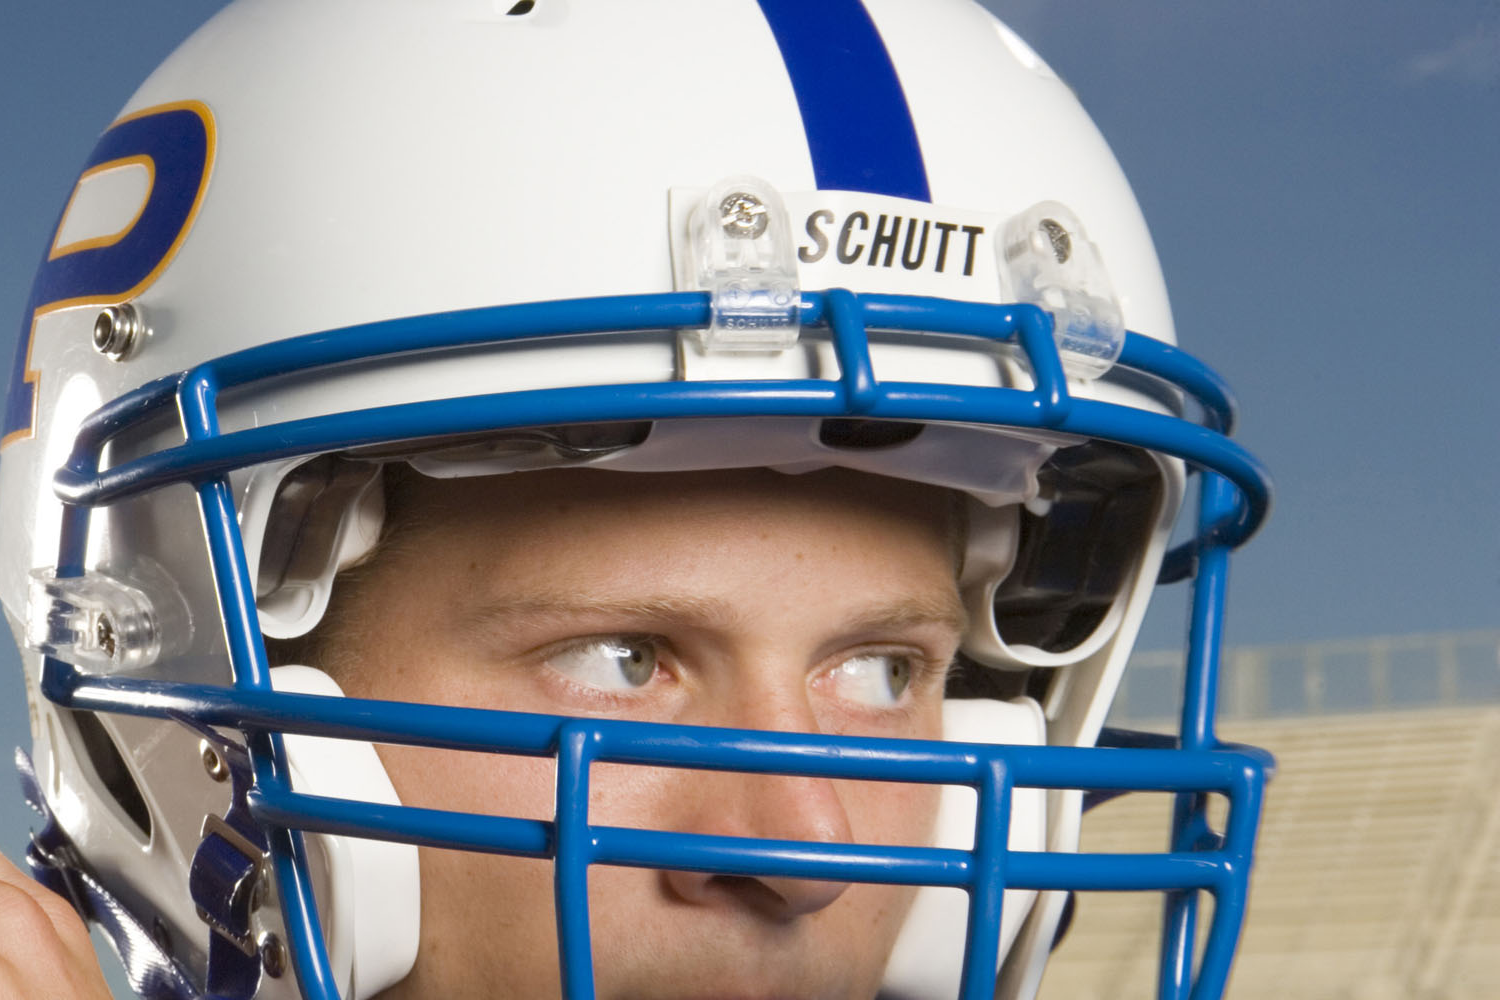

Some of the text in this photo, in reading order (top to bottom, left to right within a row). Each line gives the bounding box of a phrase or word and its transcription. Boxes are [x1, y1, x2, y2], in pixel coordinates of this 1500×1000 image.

[0, 100, 217, 452] P
[799, 209, 985, 277] SCHUTT
[725, 318, 790, 330] SCHUTT
